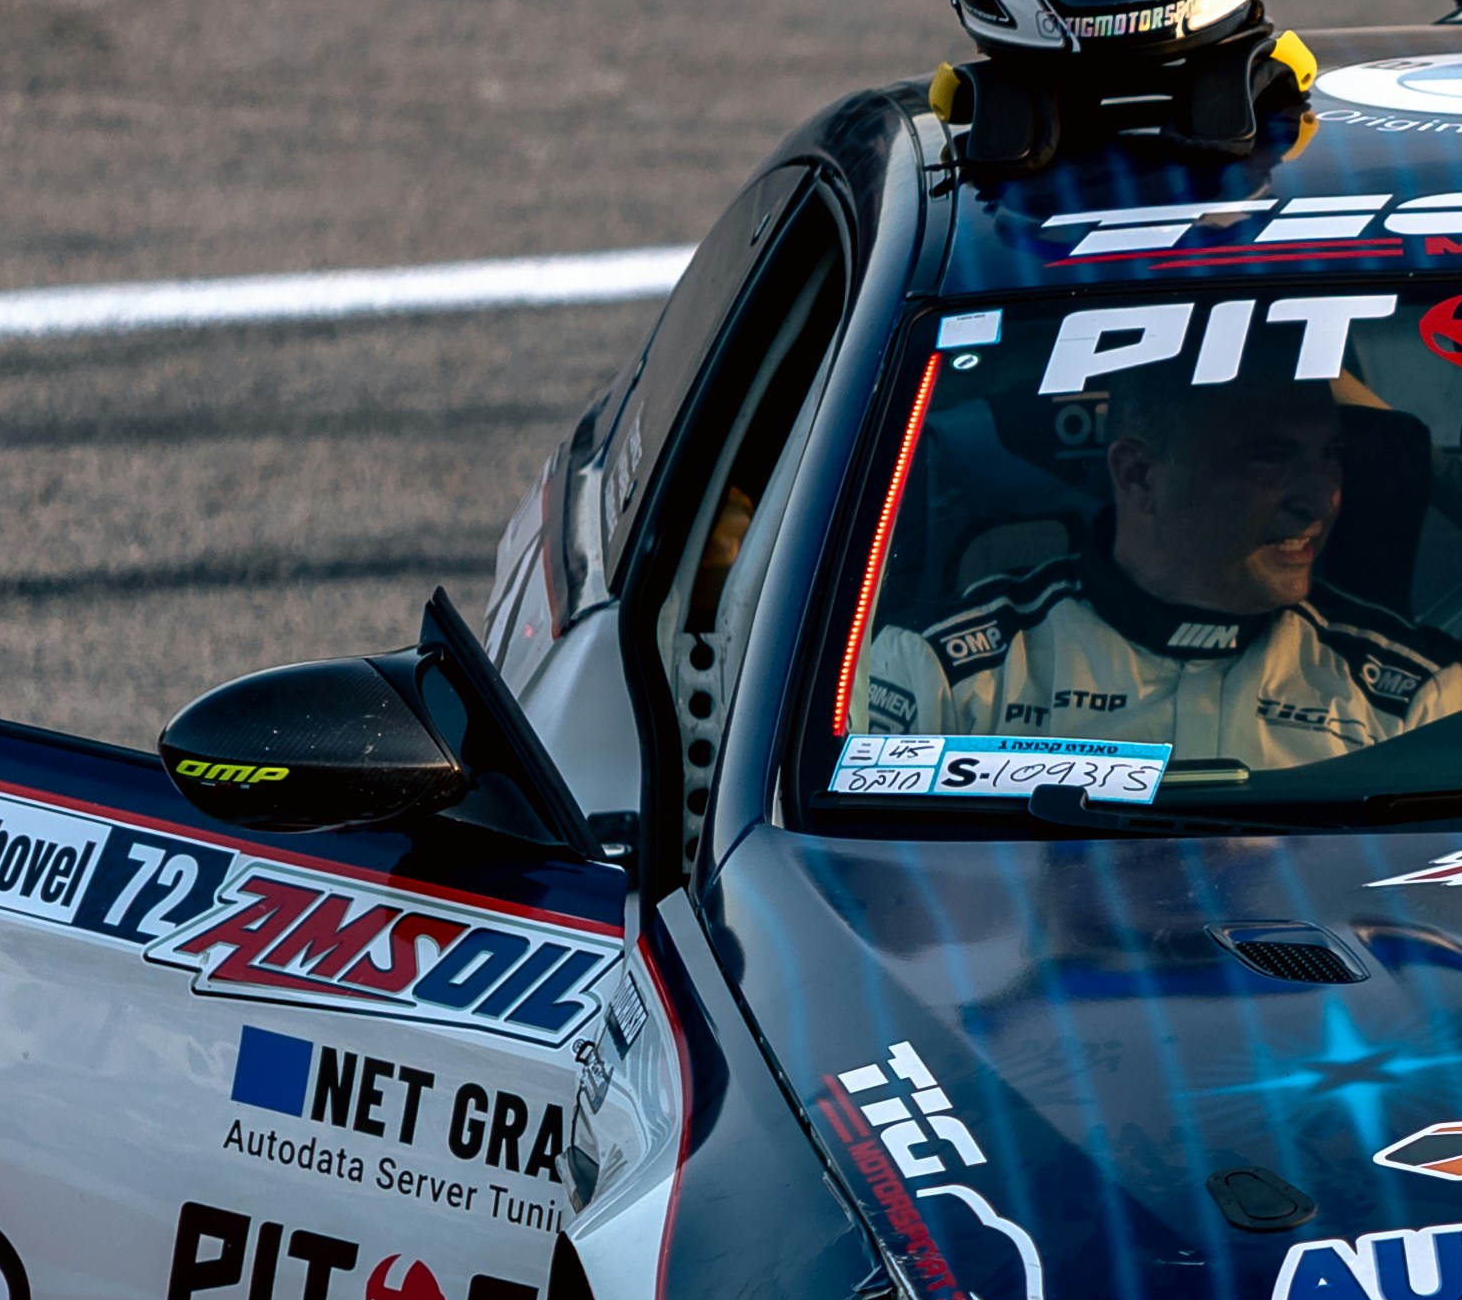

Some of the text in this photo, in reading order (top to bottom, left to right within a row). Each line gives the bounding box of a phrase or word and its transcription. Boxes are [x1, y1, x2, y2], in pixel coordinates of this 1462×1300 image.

[1038, 295, 1398, 394] PIT
[946, 627, 1002, 658] OMP
[1005, 690, 1127, 727] PIT STOP
[102, 842, 200, 935] 72
[173, 874, 605, 1033] AMSOIL
[310, 1045, 435, 1145] NET
[223, 1119, 562, 1234] Autodata Server Tuni
